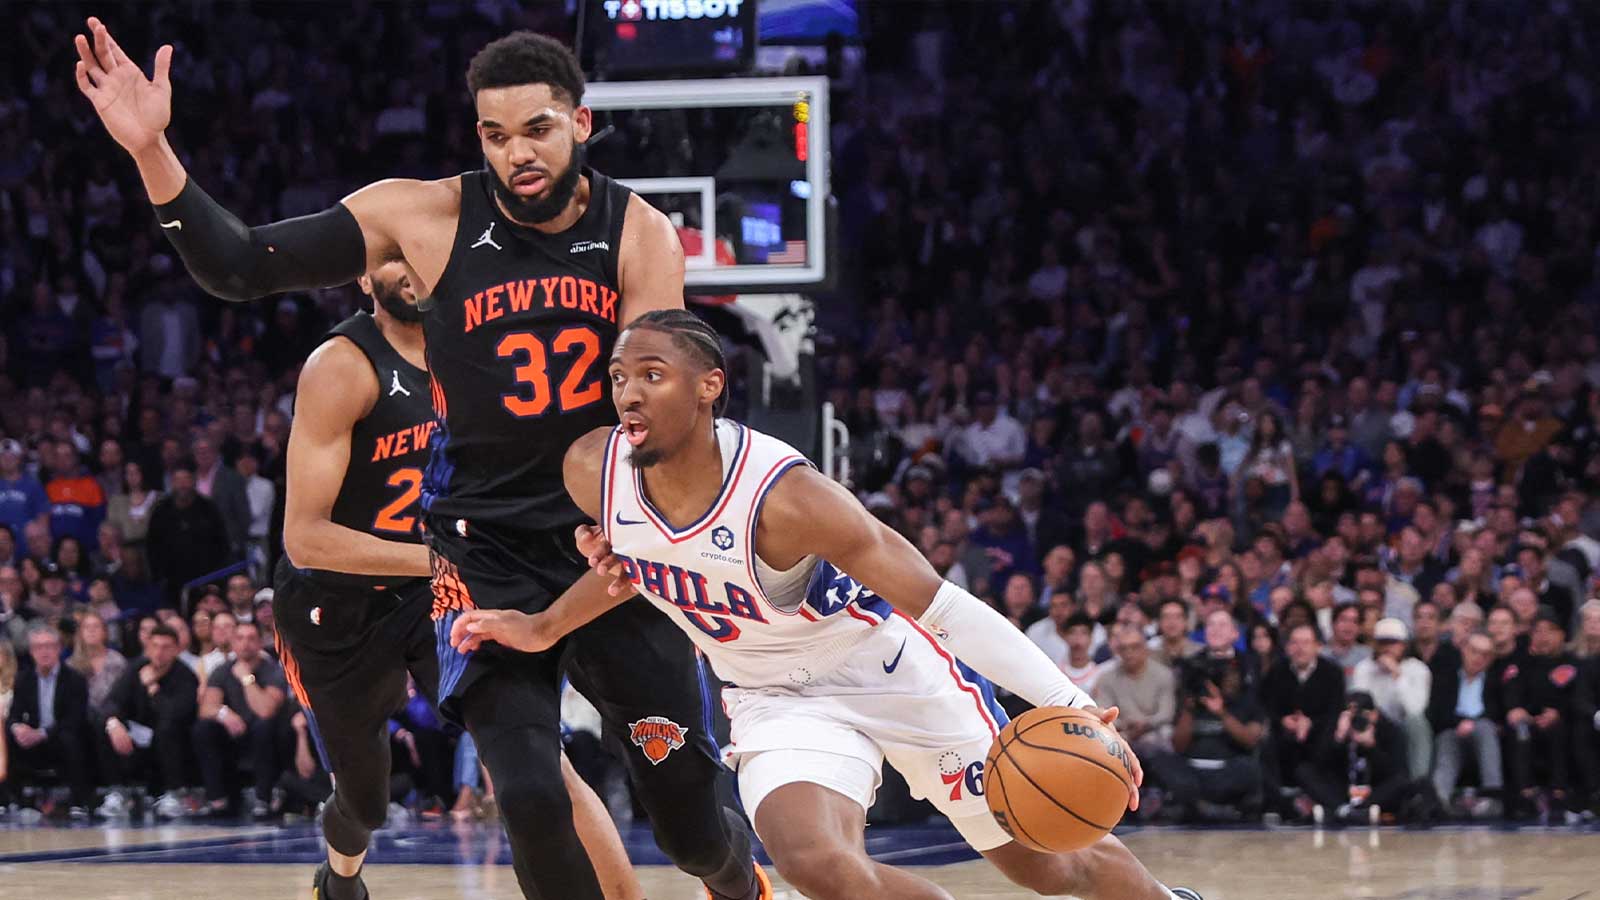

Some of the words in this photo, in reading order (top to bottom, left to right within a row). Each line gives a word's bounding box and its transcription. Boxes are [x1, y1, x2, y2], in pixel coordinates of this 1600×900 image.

[640, 0, 744, 20] TISSOT
[464, 279, 537, 333] NEW
[541, 275, 619, 324] YORK
[497, 327, 603, 417] 32
[371, 421, 434, 463] NEW
[374, 467, 426, 532] 2
[700, 551, 745, 566] crypto.com
[614, 553, 770, 625] PHILA
[632, 721, 683, 743] KNICKS
[940, 760, 985, 801] 76
